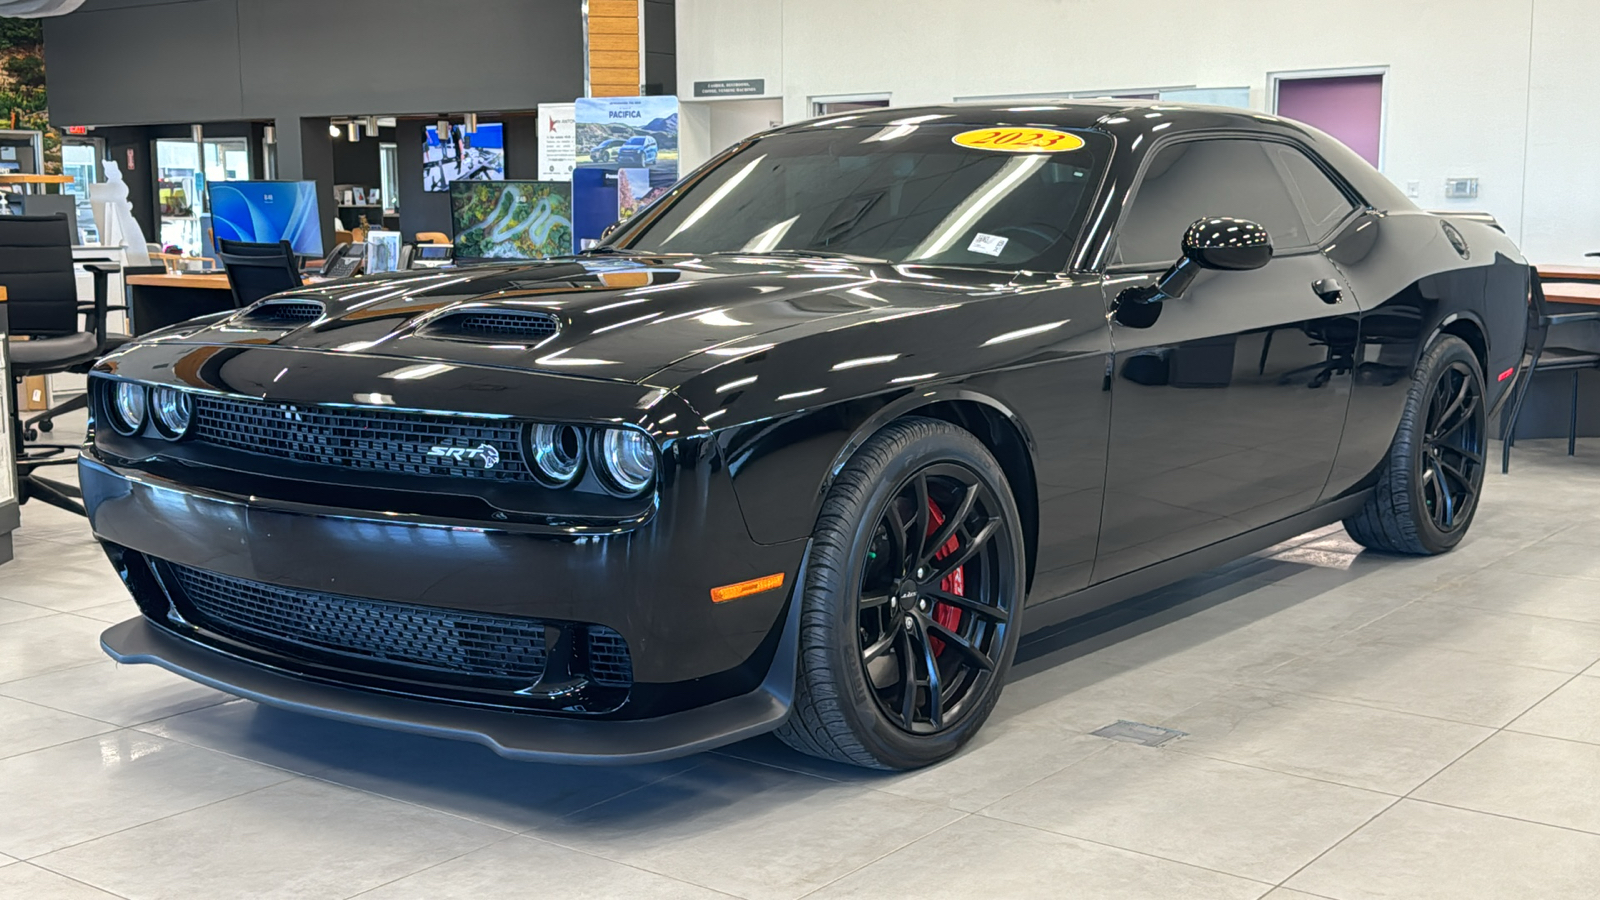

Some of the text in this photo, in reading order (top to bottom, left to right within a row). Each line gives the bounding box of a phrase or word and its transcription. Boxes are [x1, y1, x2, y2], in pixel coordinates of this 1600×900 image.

[608, 110, 641, 118] PACIFICA
[969, 131, 1066, 147] 2023
[427, 446, 484, 461] SRT
